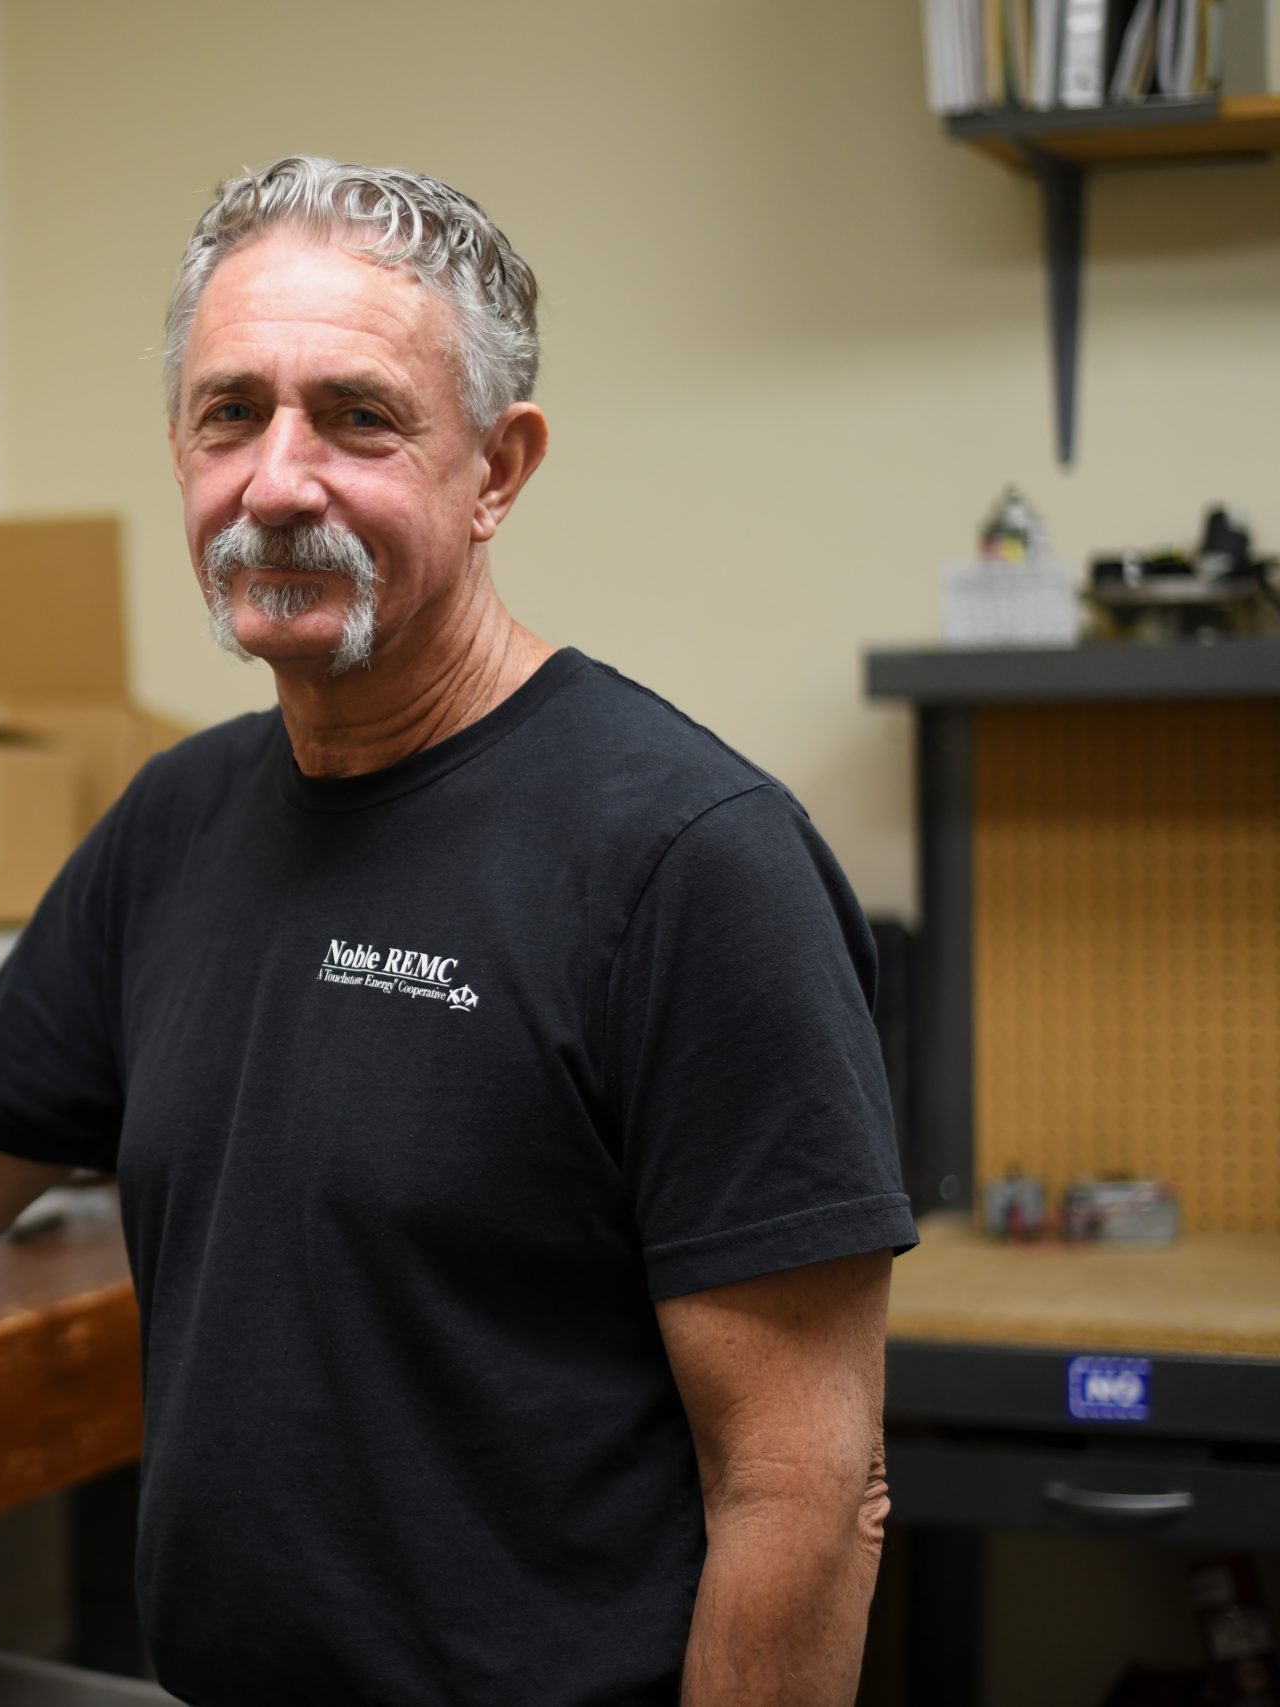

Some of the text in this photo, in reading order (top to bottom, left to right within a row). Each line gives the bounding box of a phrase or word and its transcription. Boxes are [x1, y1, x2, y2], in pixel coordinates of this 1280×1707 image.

[323, 939, 459, 983] Noble REMC
[324, 969, 364, 985] Touchstone
[398, 980, 447, 1001] Cooperative
